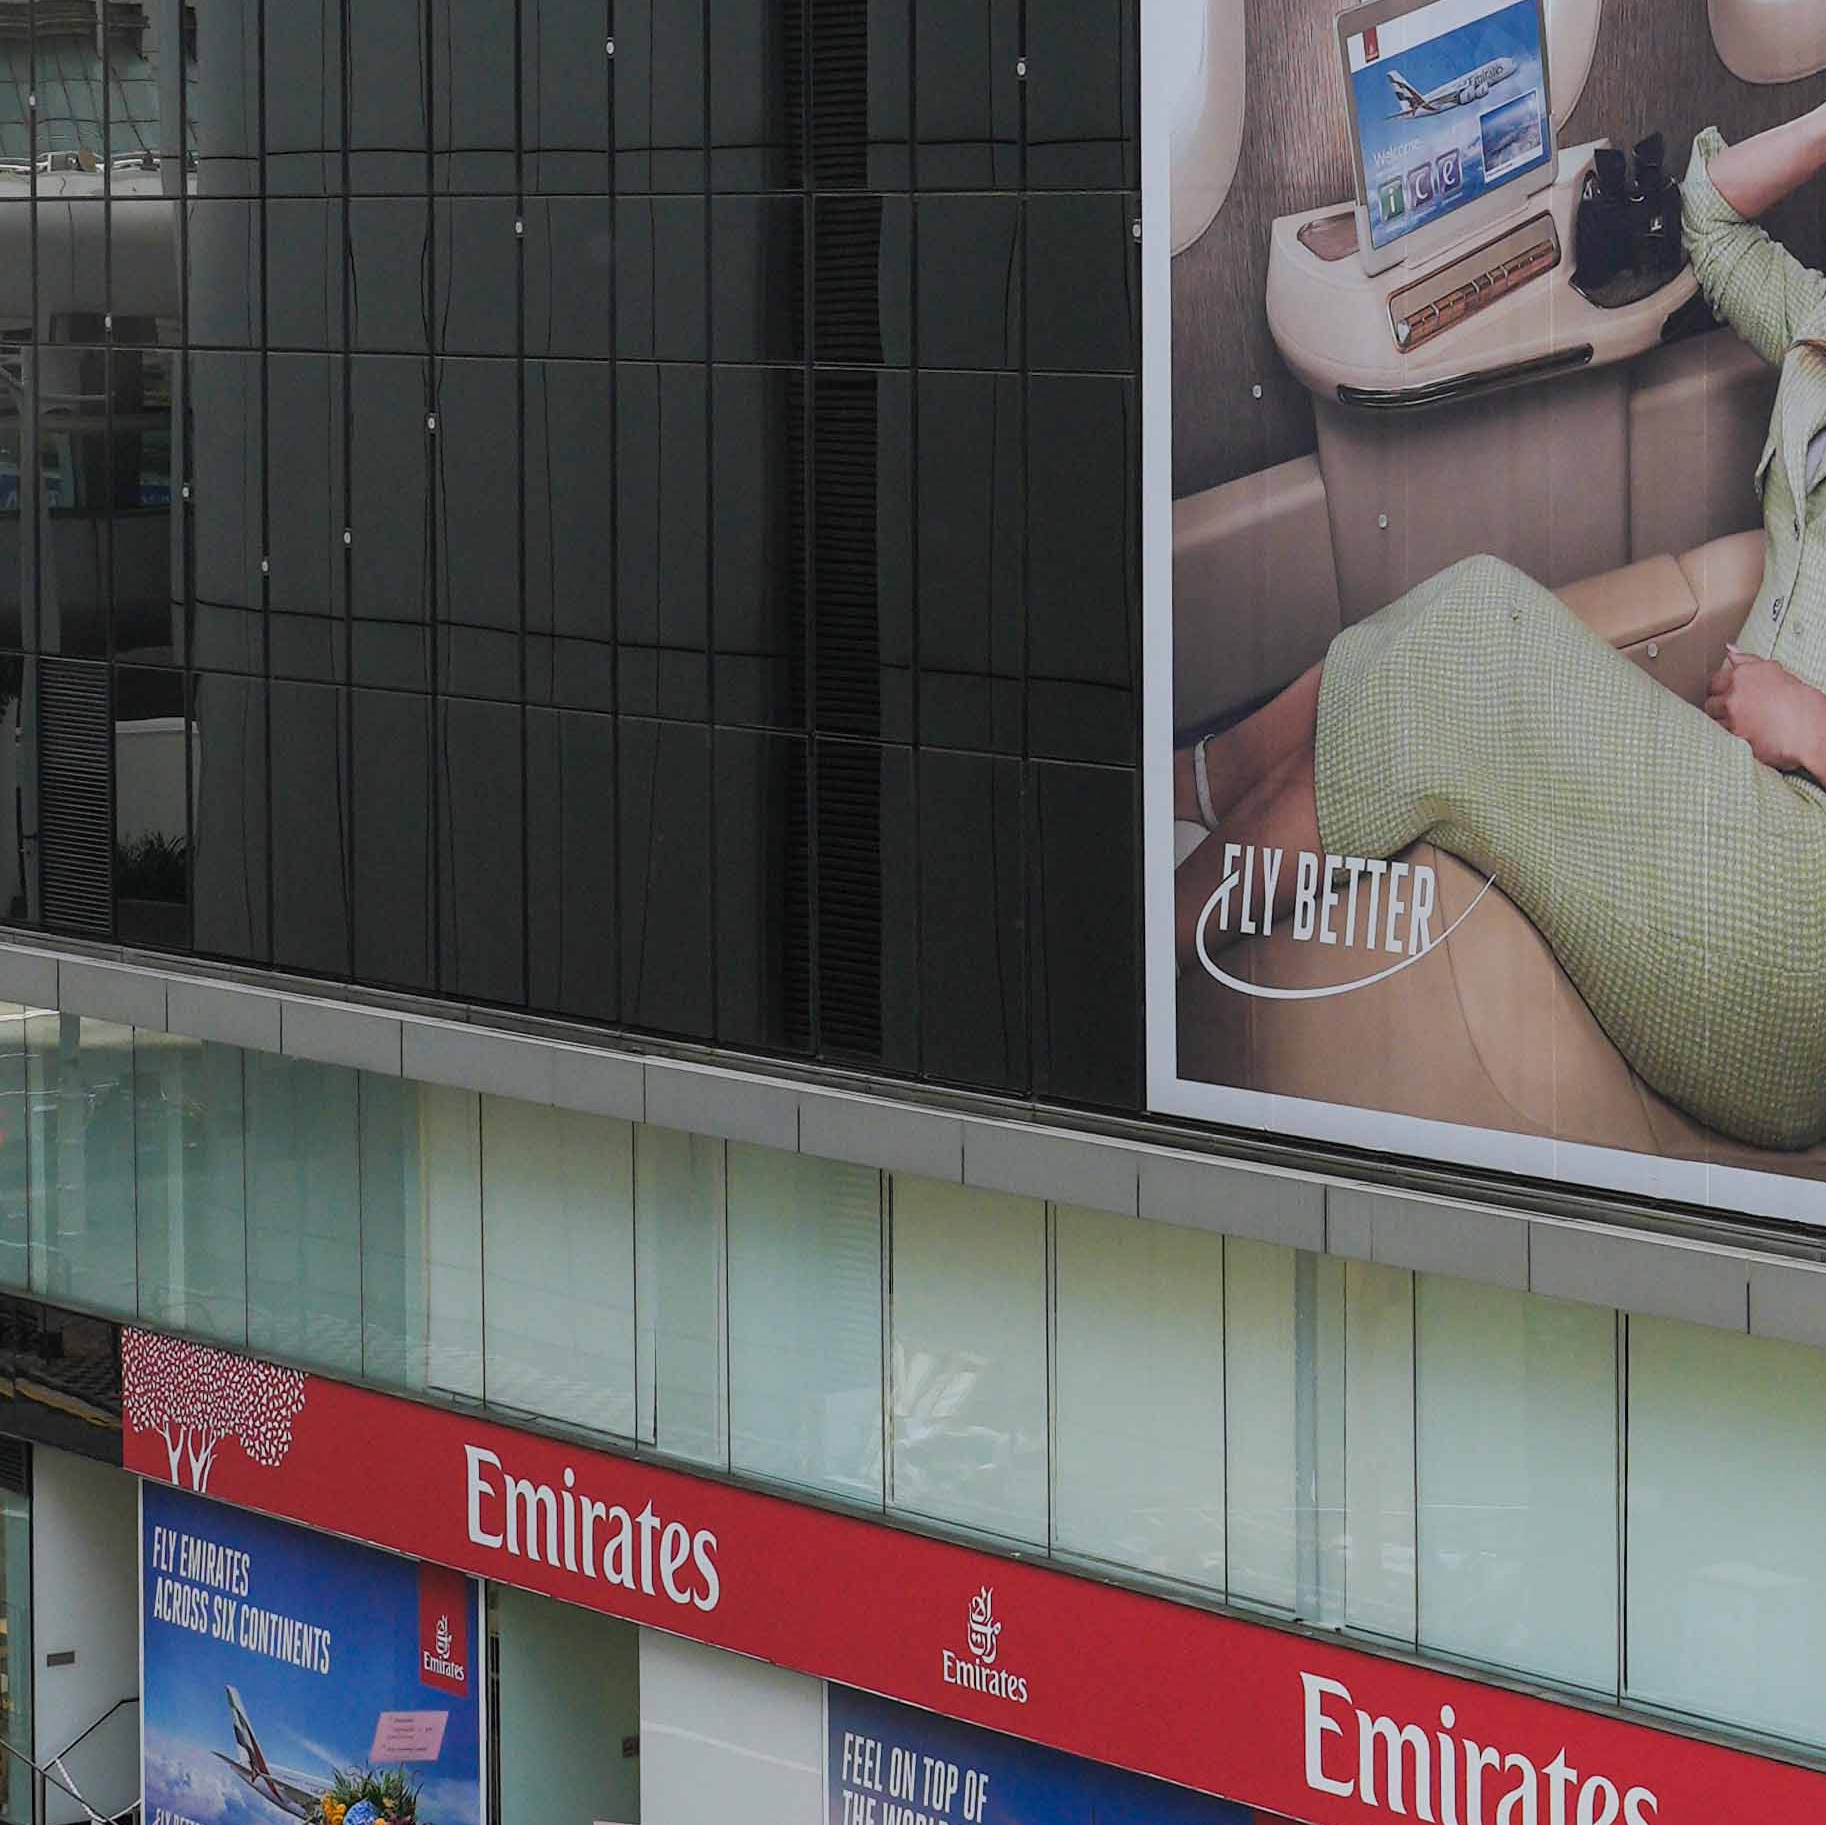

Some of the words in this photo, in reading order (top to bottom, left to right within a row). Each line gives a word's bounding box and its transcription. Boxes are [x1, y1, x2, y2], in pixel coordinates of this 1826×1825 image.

[1218, 842, 1284, 936] FLY
[1292, 850, 1436, 956] BETTER
[153, 1526, 177, 1574] FLY
[180, 1534, 251, 1598] EMIRATES
[464, 1444, 720, 1612] Emirates
[154, 1577, 209, 1634] ACROSS
[213, 1595, 236, 1644] SIX
[240, 1604, 332, 1675] CONTINENTS
[423, 1650, 465, 1681] Emirates
[943, 1649, 1028, 1703] Emirates
[842, 1731, 883, 1793] FEEL
[889, 1747, 917, 1802] ON
[923, 1756, 959, 1814] TOP
[964, 1769, 989, 1824] OF
